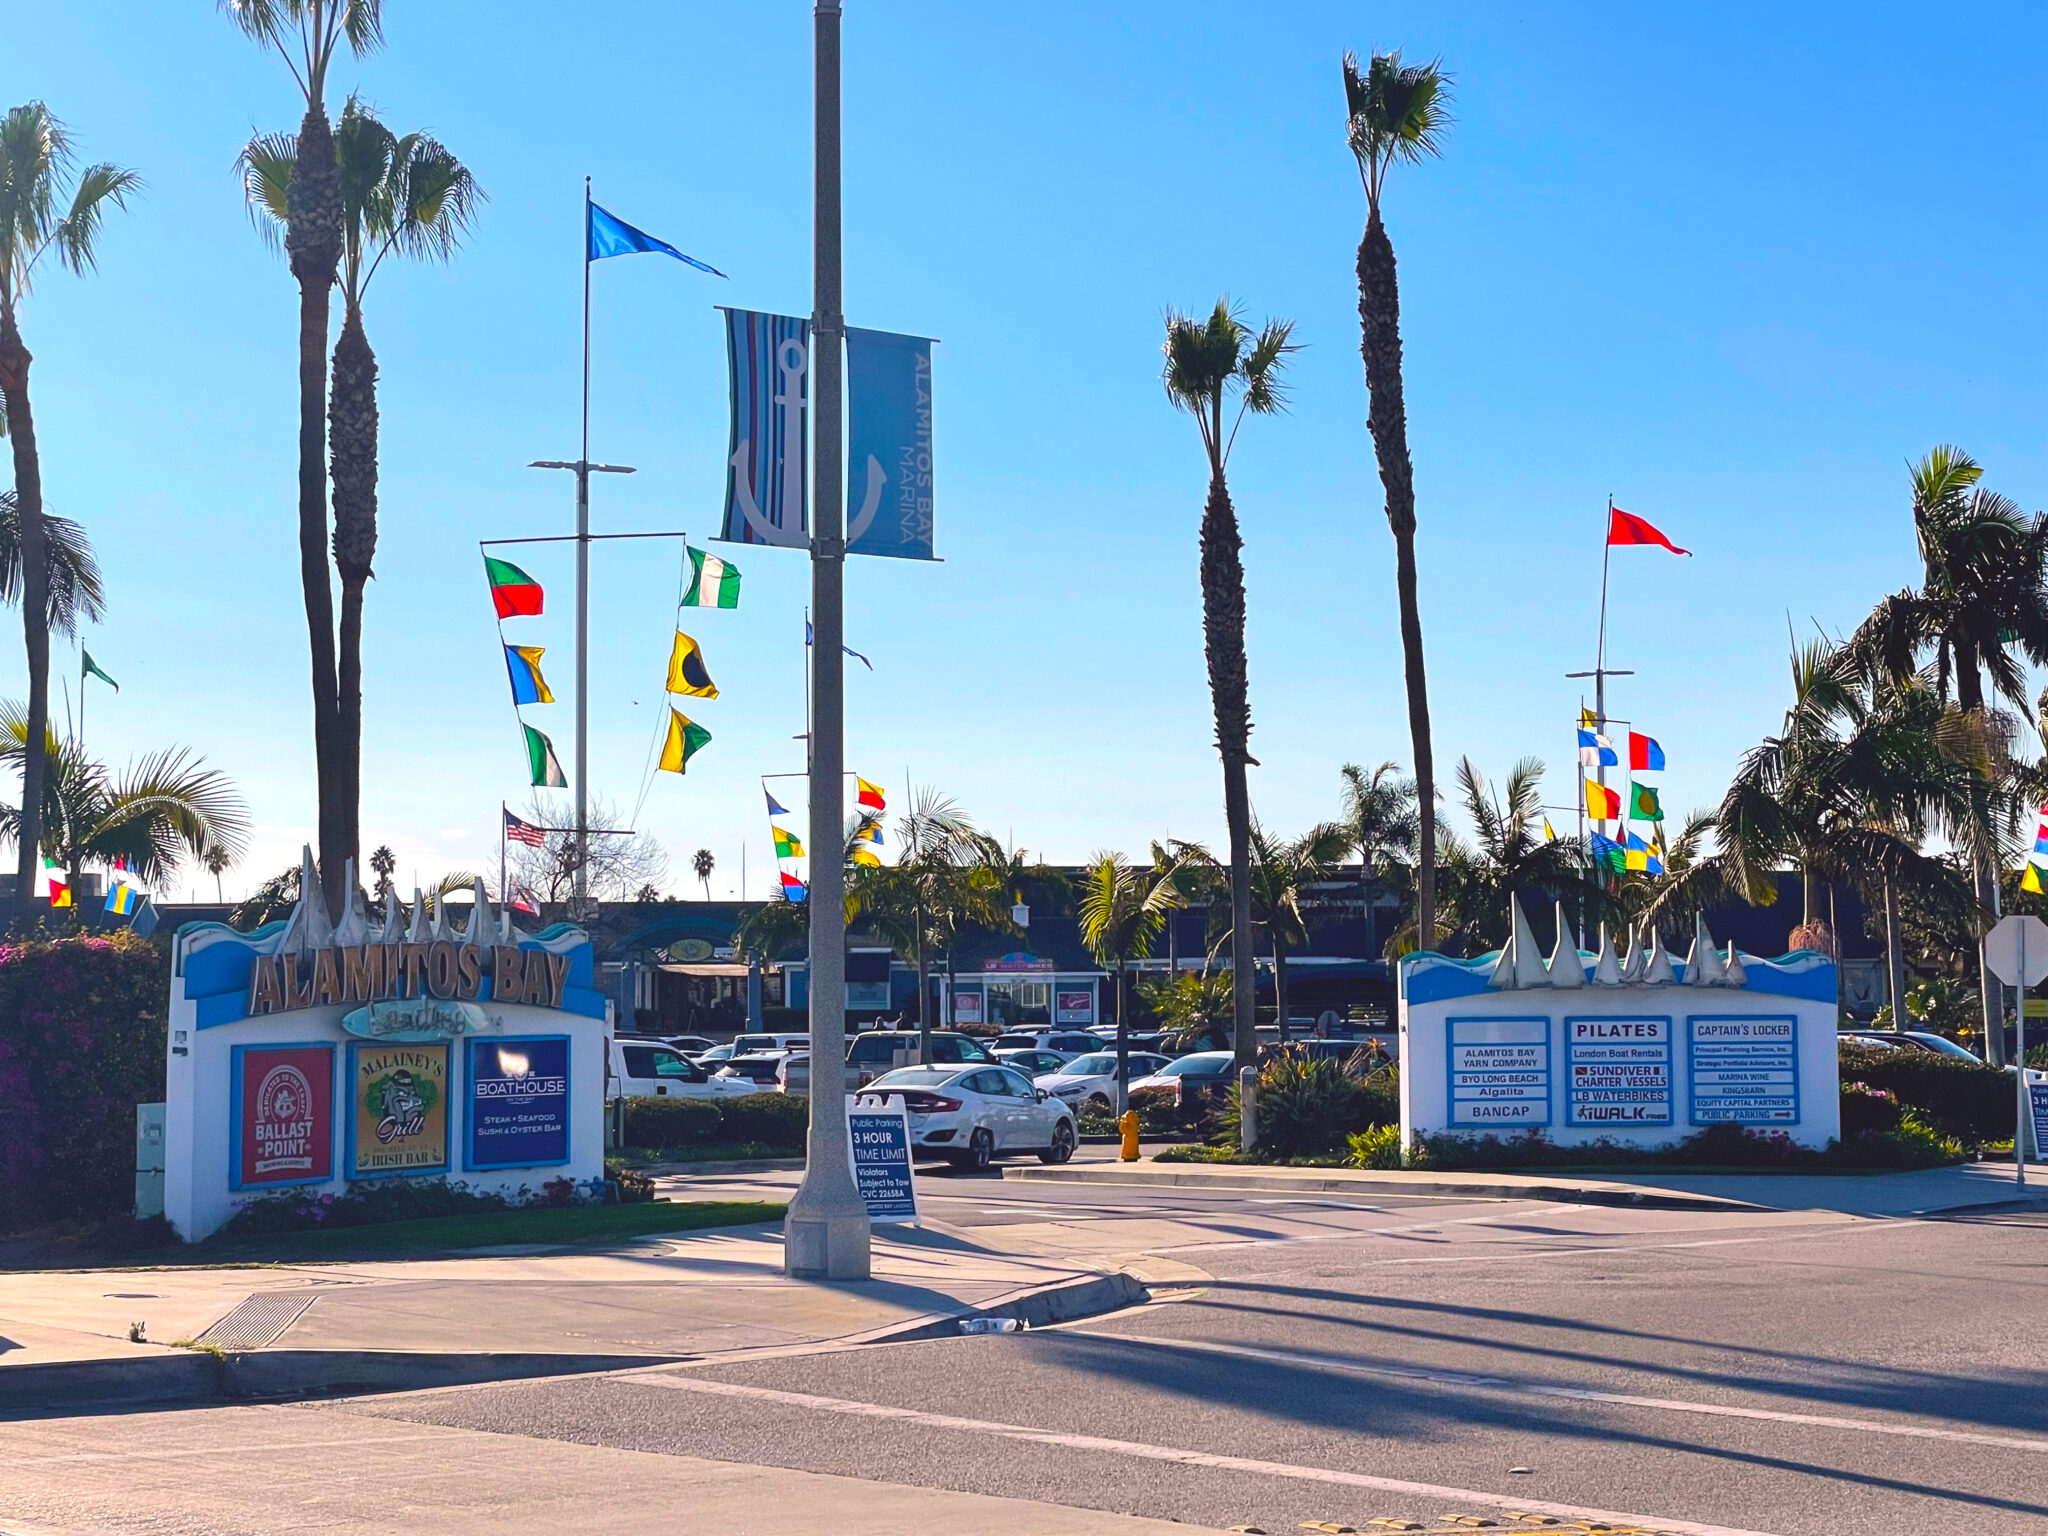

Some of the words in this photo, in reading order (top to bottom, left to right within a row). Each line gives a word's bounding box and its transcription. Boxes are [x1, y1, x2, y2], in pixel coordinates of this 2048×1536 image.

[915, 352, 931, 488] ALAMITOS
[900, 446, 915, 544] MARINA
[917, 496, 932, 546] BAY
[248, 939, 483, 1016] ALAMITOS
[491, 944, 573, 1008] BAY
[1577, 1024, 1658, 1037] PILATES
[1697, 1023, 1750, 1036] CAPTAIN'S
[1753, 1025, 1790, 1035] LOCKER
[1465, 1049, 1514, 1058] ALAMITOS
[1517, 1048, 1536, 1057] BAY
[1574, 1049, 1607, 1058] London
[1609, 1049, 1630, 1058] Boat
[1631, 1049, 1663, 1058] Rentals
[1723, 1046, 1750, 1054] Planning
[362, 1052, 444, 1079] MALAINEY'S
[1463, 1059, 1489, 1068] YARN
[1492, 1059, 1538, 1067] COMPANY
[1589, 1066, 1652, 1076] SUNDIVER
[1461, 1075, 1480, 1083] BYO
[1482, 1074, 1506, 1083] LONG
[1508, 1074, 1539, 1083] BEACH
[1575, 1077, 1622, 1087] CHARTER
[1626, 1076, 1667, 1087] VESSELS
[1750, 1073, 1770, 1081] WINE
[476, 1080, 566, 1096] BOATHOUSE
[1479, 1087, 1524, 1098] Algalita
[1722, 1086, 1766, 1095] KINGSBARN
[1575, 1091, 1590, 1101] LB
[1593, 1090, 1665, 1101] WATERBIKES
[2033, 1096, 2040, 1105] 3
[1472, 1106, 1530, 1118] BANCAP
[1702, 1110, 1731, 1120] PUBLIC
[1733, 1110, 1770, 1119] PARKING
[851, 1119, 874, 1128] Public
[875, 1119, 903, 1129] Parking
[255, 1121, 313, 1140] BALLAST
[376, 1116, 424, 1144] Grill
[853, 1132, 861, 1144] 3
[863, 1132, 893, 1144] HOUR
[265, 1139, 306, 1157] POINT
[372, 1153, 403, 1167] IRISH
[406, 1151, 429, 1164] BAR
[855, 1148, 880, 1160] TIME
[881, 1148, 905, 1160] LIMIT
[858, 1168, 889, 1176] Violators
[859, 1179, 886, 1188] Subject
[886, 1179, 895, 1187] to
[895, 1178, 910, 1187] Tow
[861, 1190, 878, 1198] CVC
